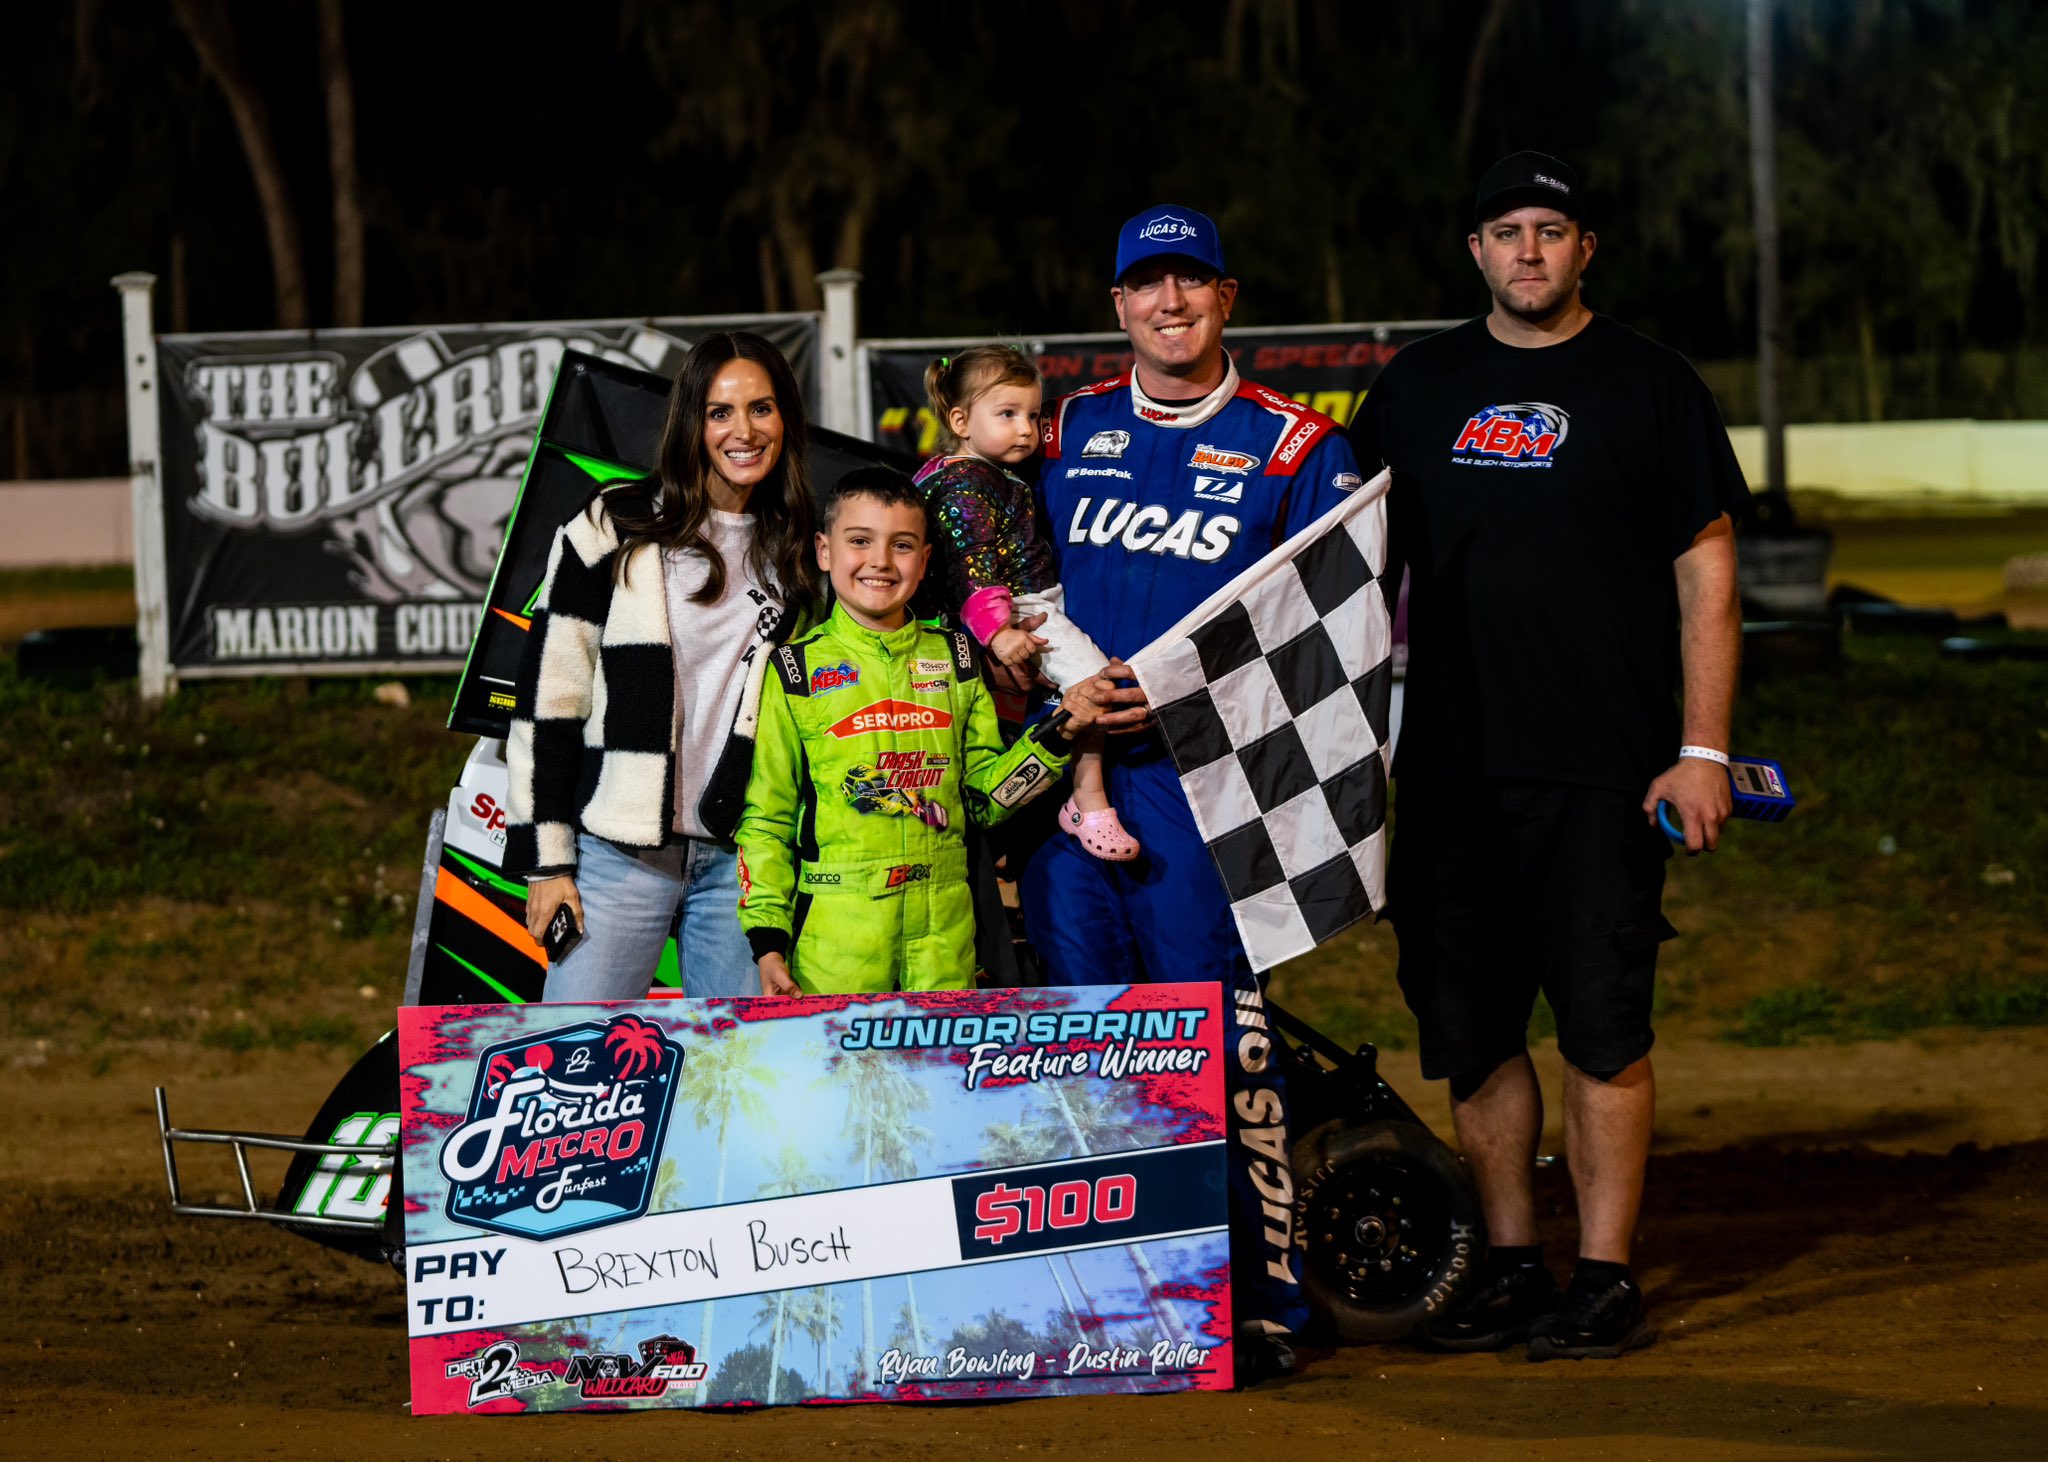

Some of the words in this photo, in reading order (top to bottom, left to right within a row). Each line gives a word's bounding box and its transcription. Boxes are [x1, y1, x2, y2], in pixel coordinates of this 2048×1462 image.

[1139, 223, 1178, 239] LUCAS
[1180, 225, 1198, 237] OIL
[199, 360, 337, 422] THE
[1140, 406, 1179, 422] LUCAS
[1082, 436, 1124, 455] KBM
[1278, 422, 1319, 464] sparco
[1452, 415, 1558, 460] KBM
[1192, 451, 1249, 468] BALLEW
[1451, 457, 1473, 465] KYLE
[1473, 459, 1499, 467] BUSCH
[1499, 460, 1553, 468] MOTORSPORTS
[1068, 497, 1241, 563] LUCAS
[214, 606, 378, 659] MARION
[954, 632, 972, 669] sparco
[779, 645, 802, 684] sparco
[811, 670, 859, 693] KBM
[852, 711, 935, 730] SERVPRO
[875, 750, 927, 771] CRASH
[885, 767, 947, 789] CIRCUIT
[843, 1014, 1019, 1050] JUNIOR
[1027, 1010, 1206, 1043] SPRINT
[966, 1042, 1089, 1090] Feature
[1100, 1038, 1207, 1079] Winner
[443, 1076, 645, 1183] Florida
[495, 1119, 645, 1185] MICRO
[536, 1164, 607, 1210] Funfest
[1234, 1087, 1299, 1286] LUCAS
[975, 1173, 1137, 1245] $100
[413, 1247, 508, 1283] PAY
[553, 1238, 720, 1294] BREXTON
[416, 1294, 484, 1325] TO:
[447, 1359, 485, 1376] DIRT
[500, 1372, 552, 1393] MEDIA
[650, 1364, 705, 1379] 600
[878, 1349, 937, 1384] Ryan
[946, 1347, 1037, 1380] Bowling
[1063, 1342, 1140, 1375] Dustin
[1150, 1340, 1210, 1375] Roller
[585, 1376, 664, 1395] WILDCARD
